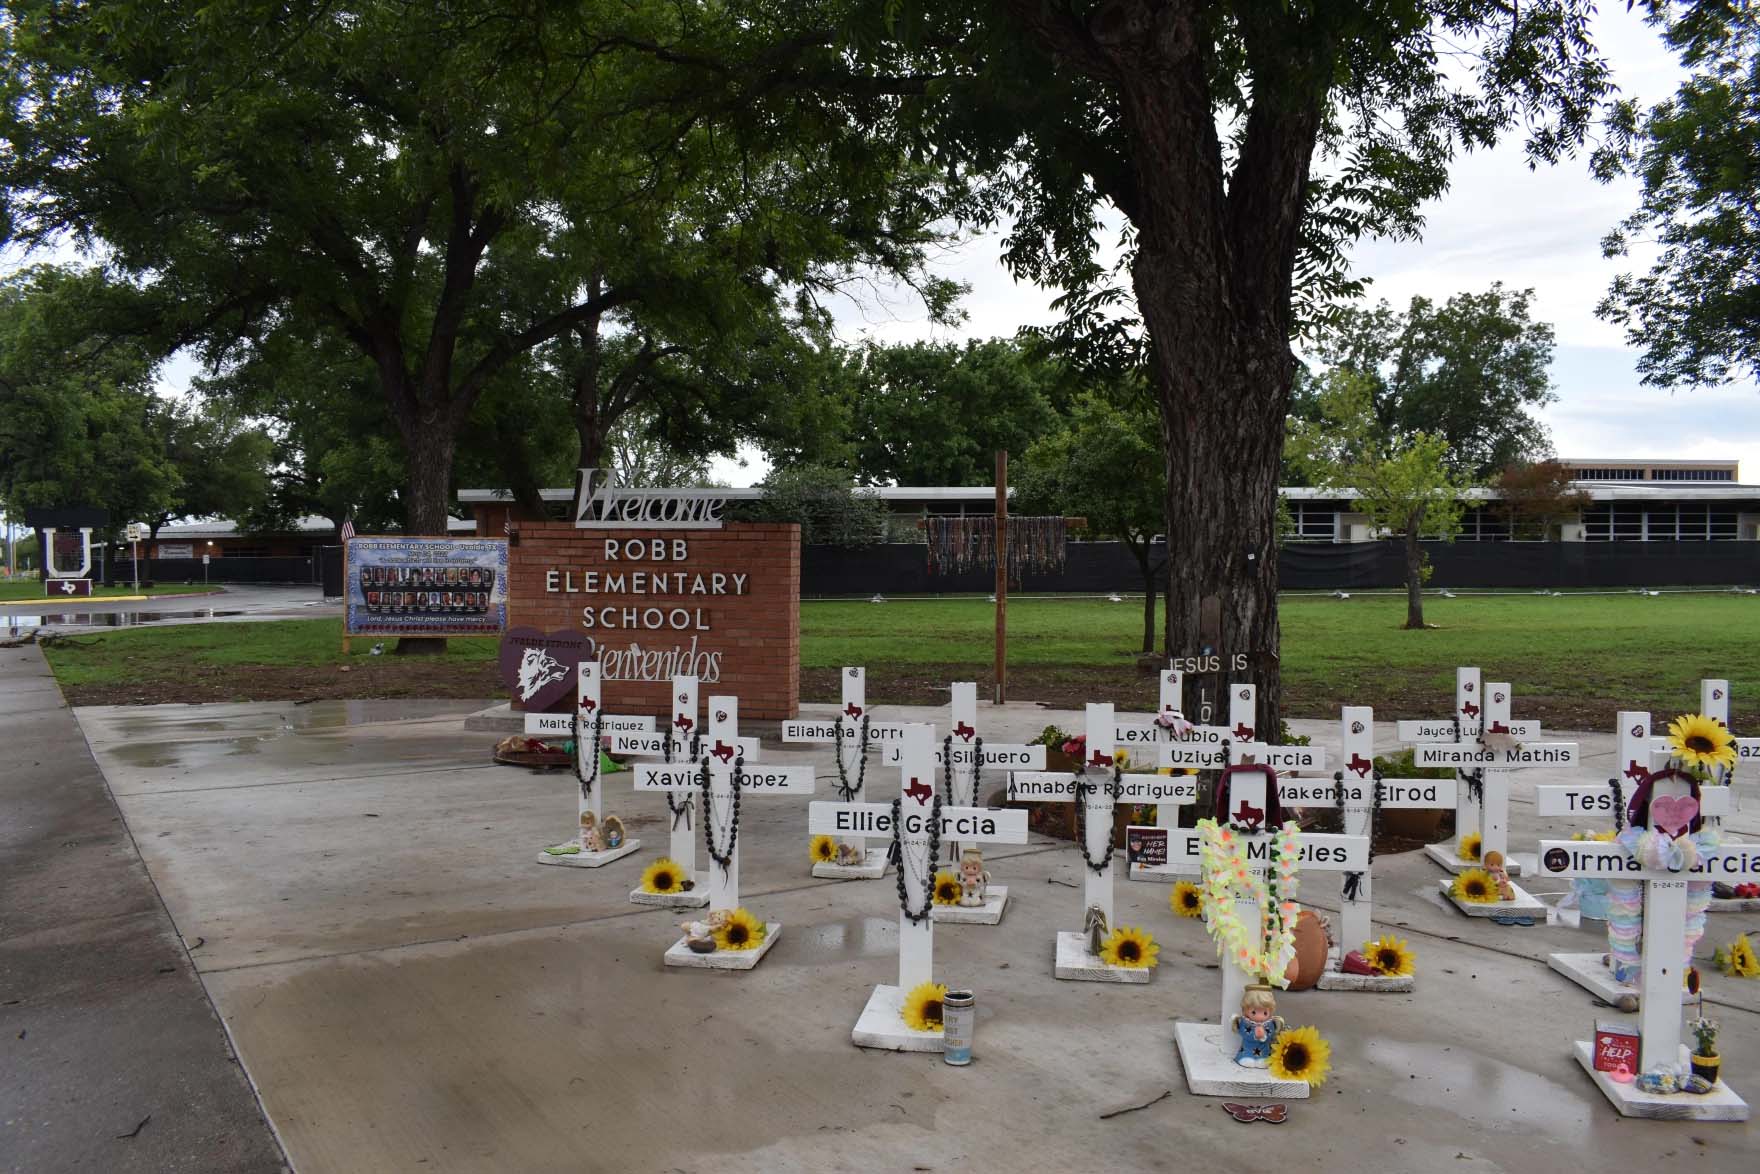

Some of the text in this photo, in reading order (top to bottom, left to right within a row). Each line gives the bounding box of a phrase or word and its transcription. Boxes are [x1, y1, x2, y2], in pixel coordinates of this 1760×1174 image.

[576, 468, 727, 522] Welcome
[604, 539, 688, 561] ROBB
[546, 570, 747, 595] ELEMENTARY
[582, 606, 711, 630] SCHOOL
[586, 635, 722, 682] ienvenidos
[1231, 654, 1248, 671] IS
[539, 719, 576, 729] Maite
[1417, 726, 1454, 738] Jayce
[1116, 728, 1157, 742] Lexi
[1423, 749, 1571, 762] Miranda Mathis
[1008, 781, 1097, 794] Annabee
[1378, 785, 1436, 801] Elrod
[836, 811, 996, 835] Ellie Garcia
[1601, 1045, 1633, 1059] HELP
